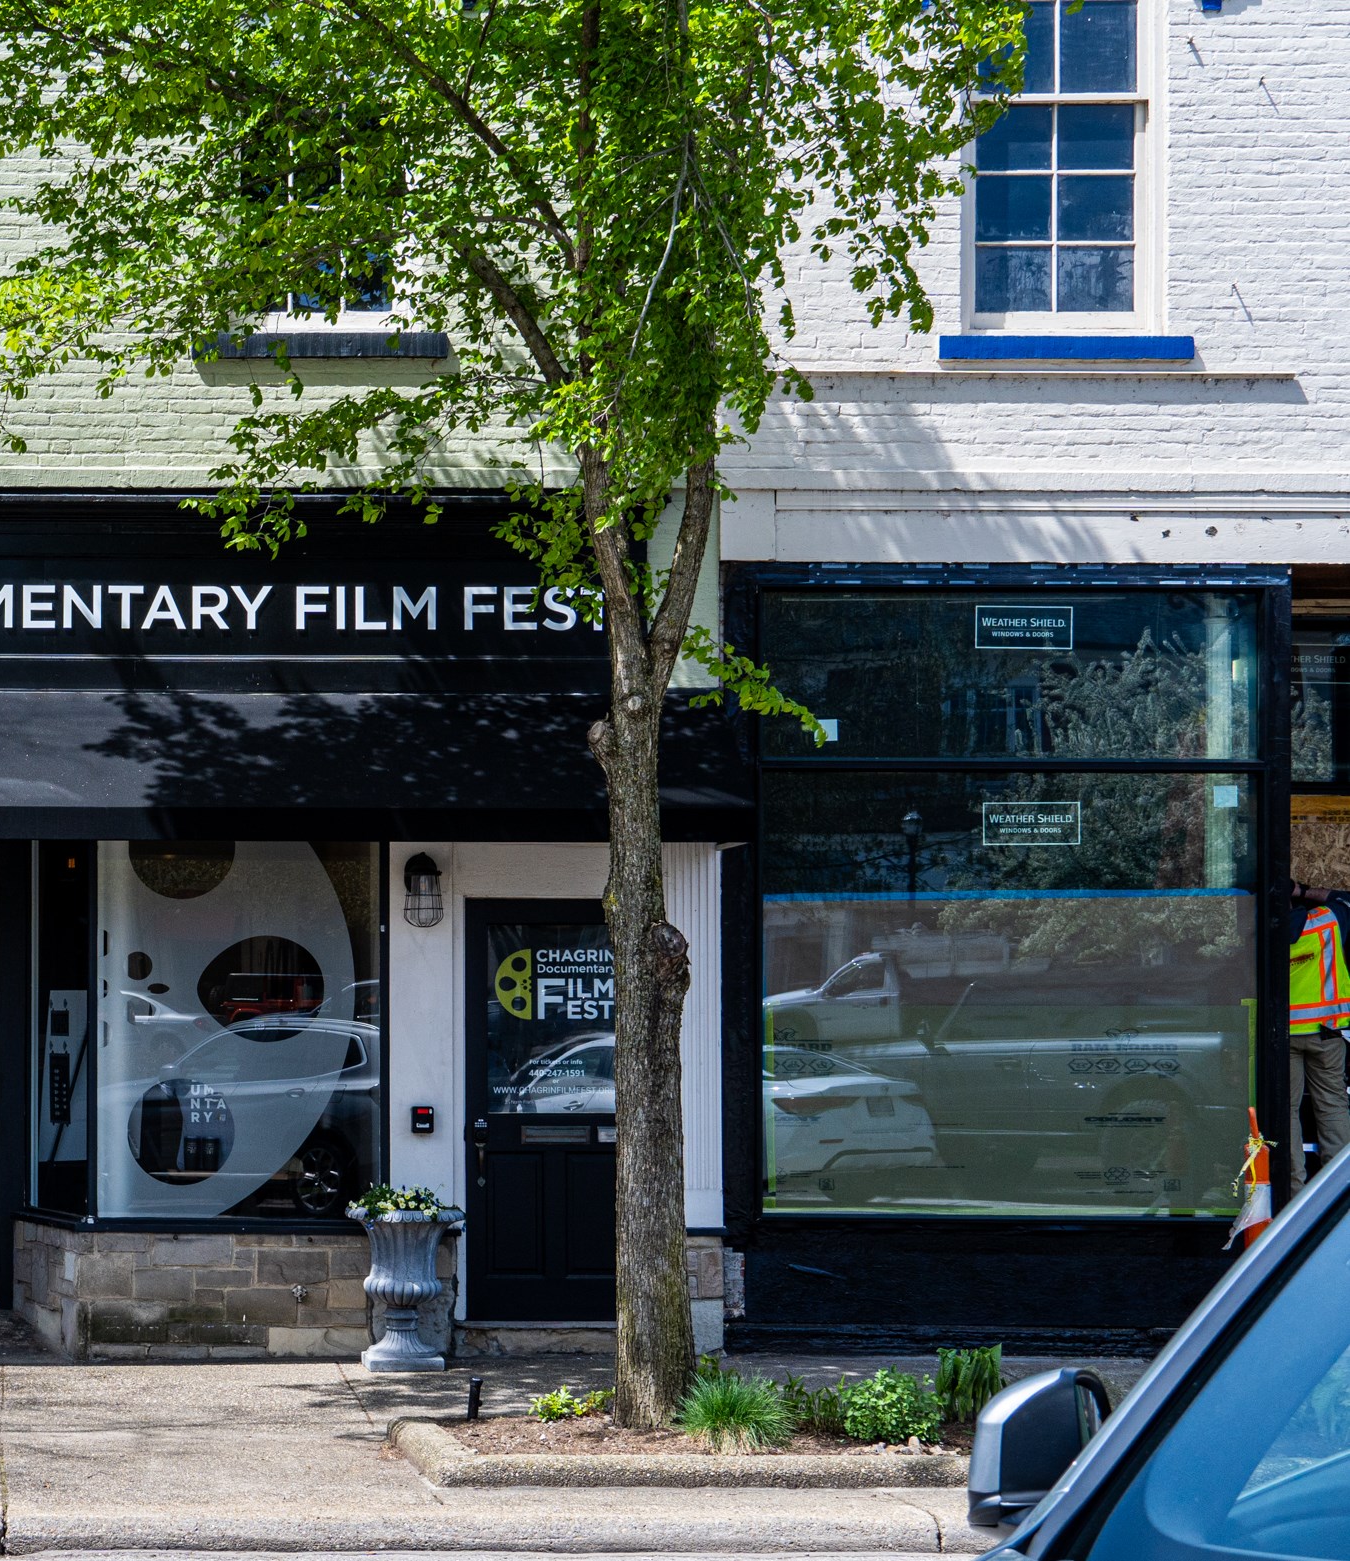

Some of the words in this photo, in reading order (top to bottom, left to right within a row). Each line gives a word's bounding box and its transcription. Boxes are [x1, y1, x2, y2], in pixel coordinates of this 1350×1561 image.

[295, 585, 437, 630] FILM
[463, 586, 605, 631] FEST
[982, 617, 1027, 627] WEATHER
[989, 813, 1034, 824] WEATHER
[536, 949, 614, 962] CHAGRIN
[537, 964, 615, 975] Documentary
[528, 1069, 585, 1077] 440-247-1591
